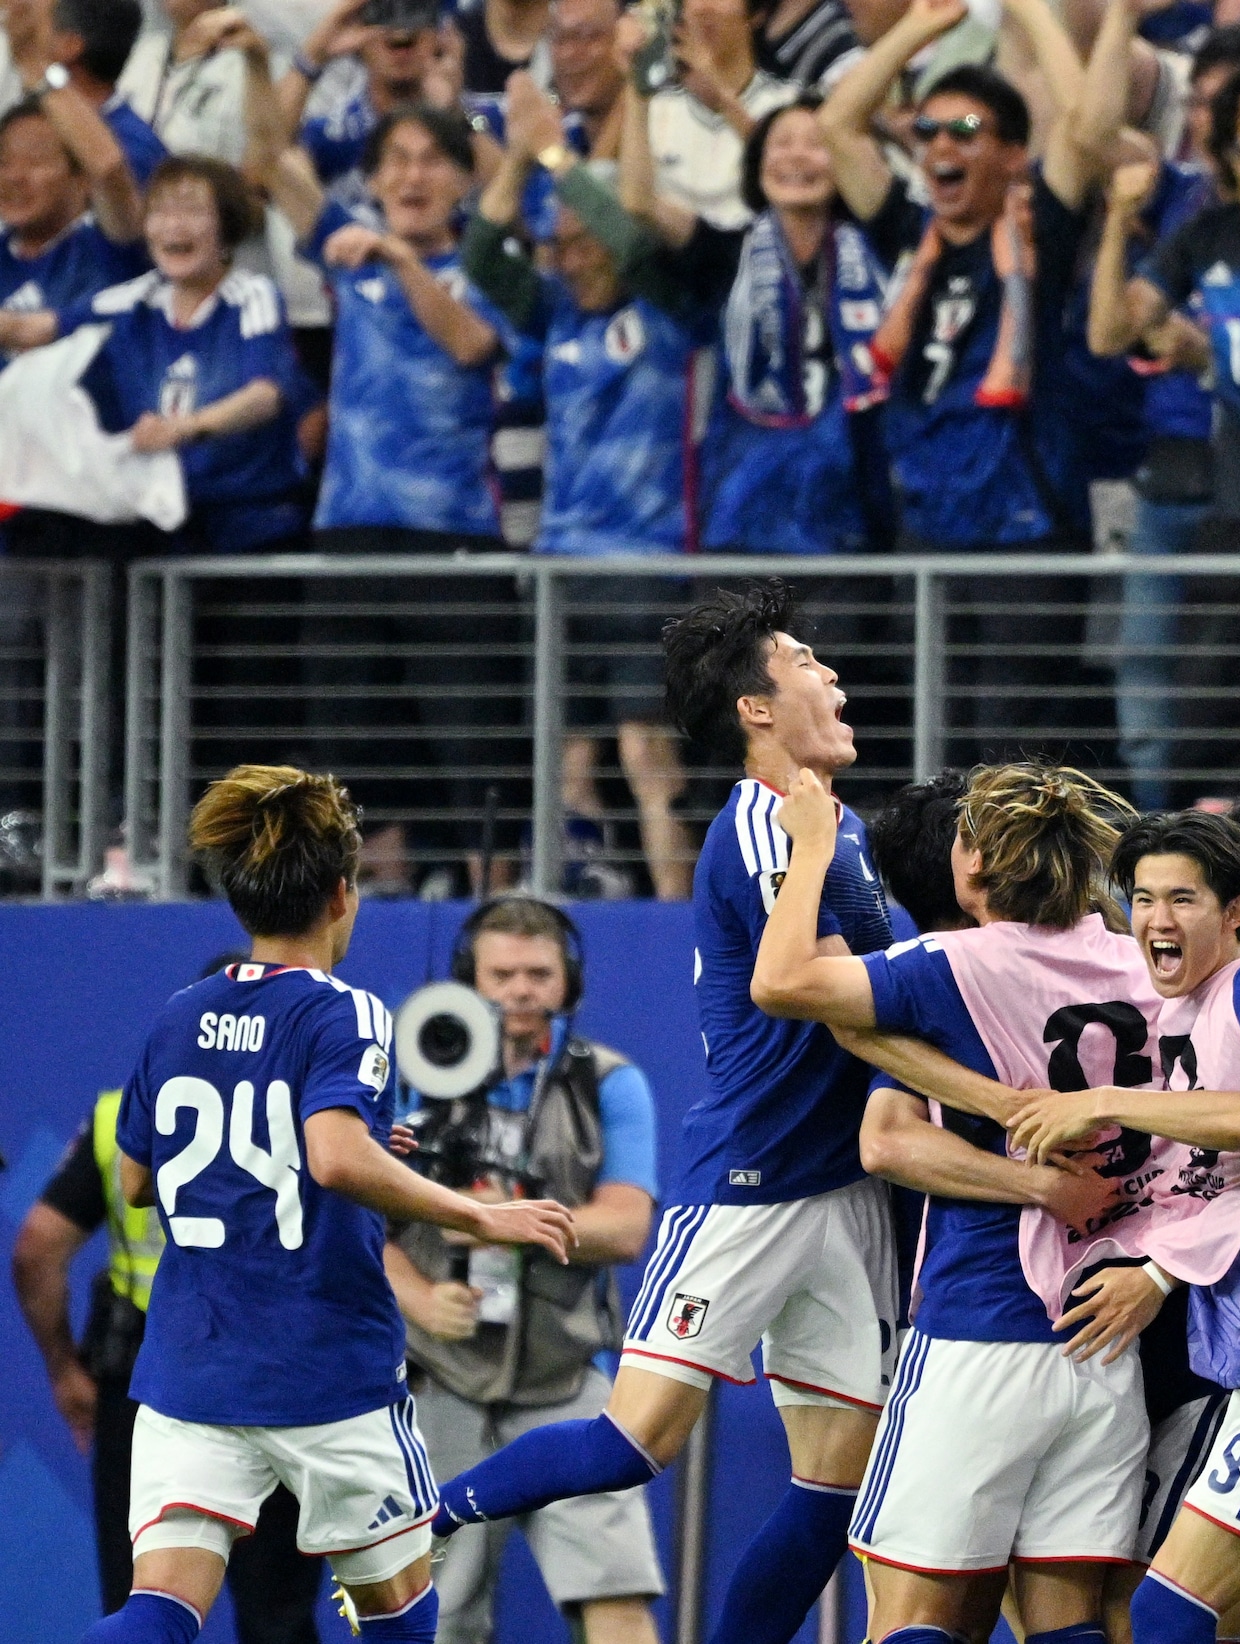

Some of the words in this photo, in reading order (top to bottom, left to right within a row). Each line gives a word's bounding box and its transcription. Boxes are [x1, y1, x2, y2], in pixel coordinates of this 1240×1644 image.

[923, 342, 952, 404] 7
[197, 1012, 266, 1053] SANO
[155, 1076, 304, 1251] 24
